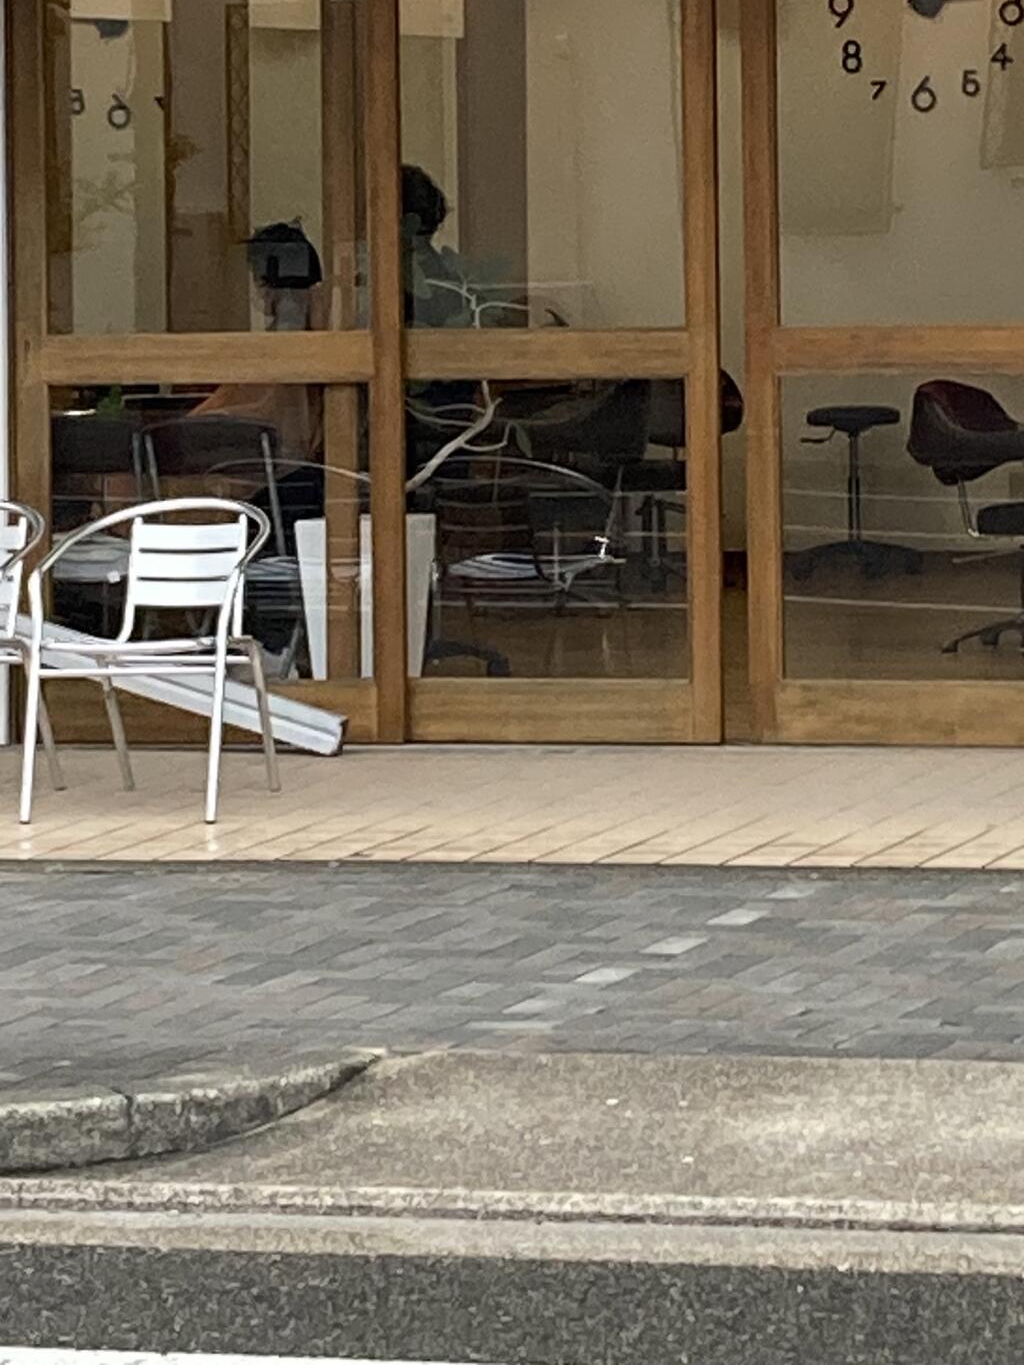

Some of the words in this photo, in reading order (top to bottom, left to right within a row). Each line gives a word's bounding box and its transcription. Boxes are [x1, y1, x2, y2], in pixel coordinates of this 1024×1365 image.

[842, 40, 863, 74] 8
[990, 43, 1013, 70] 4
[870, 81, 886, 100] 7
[911, 76, 937, 112] 6
[962, 70, 980, 97] 5
